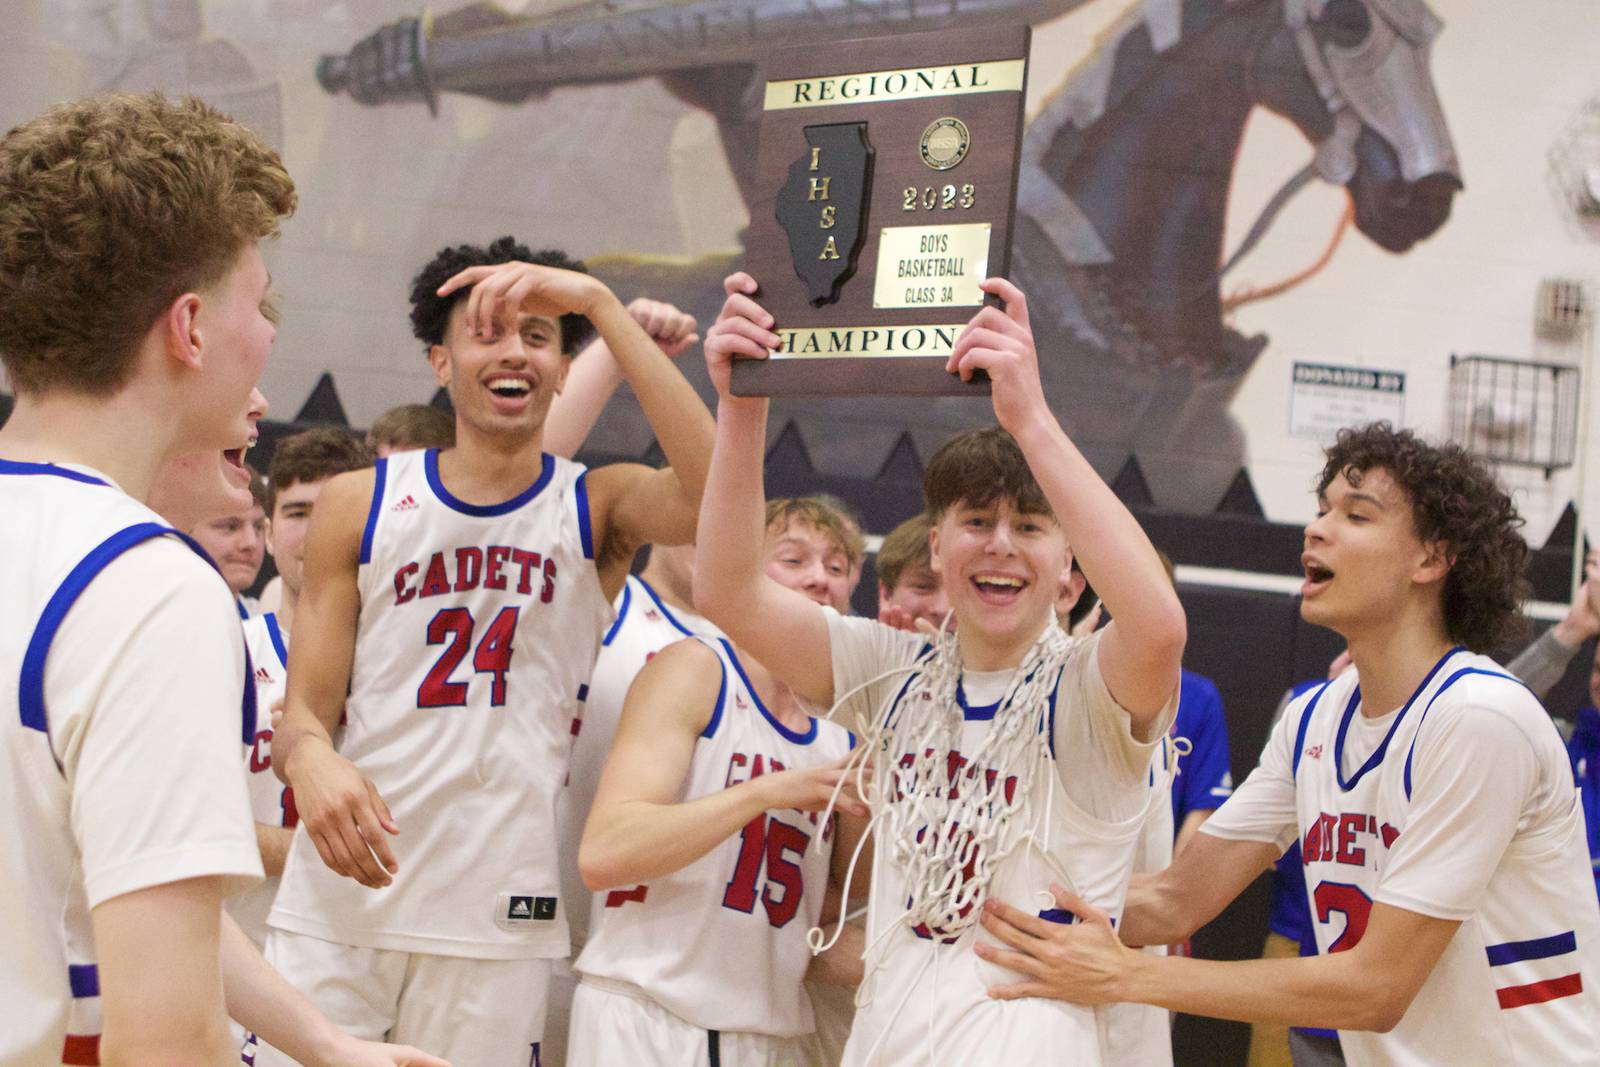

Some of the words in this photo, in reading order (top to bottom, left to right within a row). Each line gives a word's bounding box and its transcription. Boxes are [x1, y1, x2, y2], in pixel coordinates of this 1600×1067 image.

[793, 65, 989, 104] REGIONAL
[902, 183, 976, 212] 2023
[919, 234, 949, 254] BOYS
[897, 257, 965, 279] BASKETBALL
[904, 287, 935, 305] CLASS
[940, 285, 954, 304] 3A
[770, 327, 957, 354] HAMPION
[393, 545, 557, 606] CADETS
[416, 606, 521, 709] 24
[722, 812, 812, 929] 15
